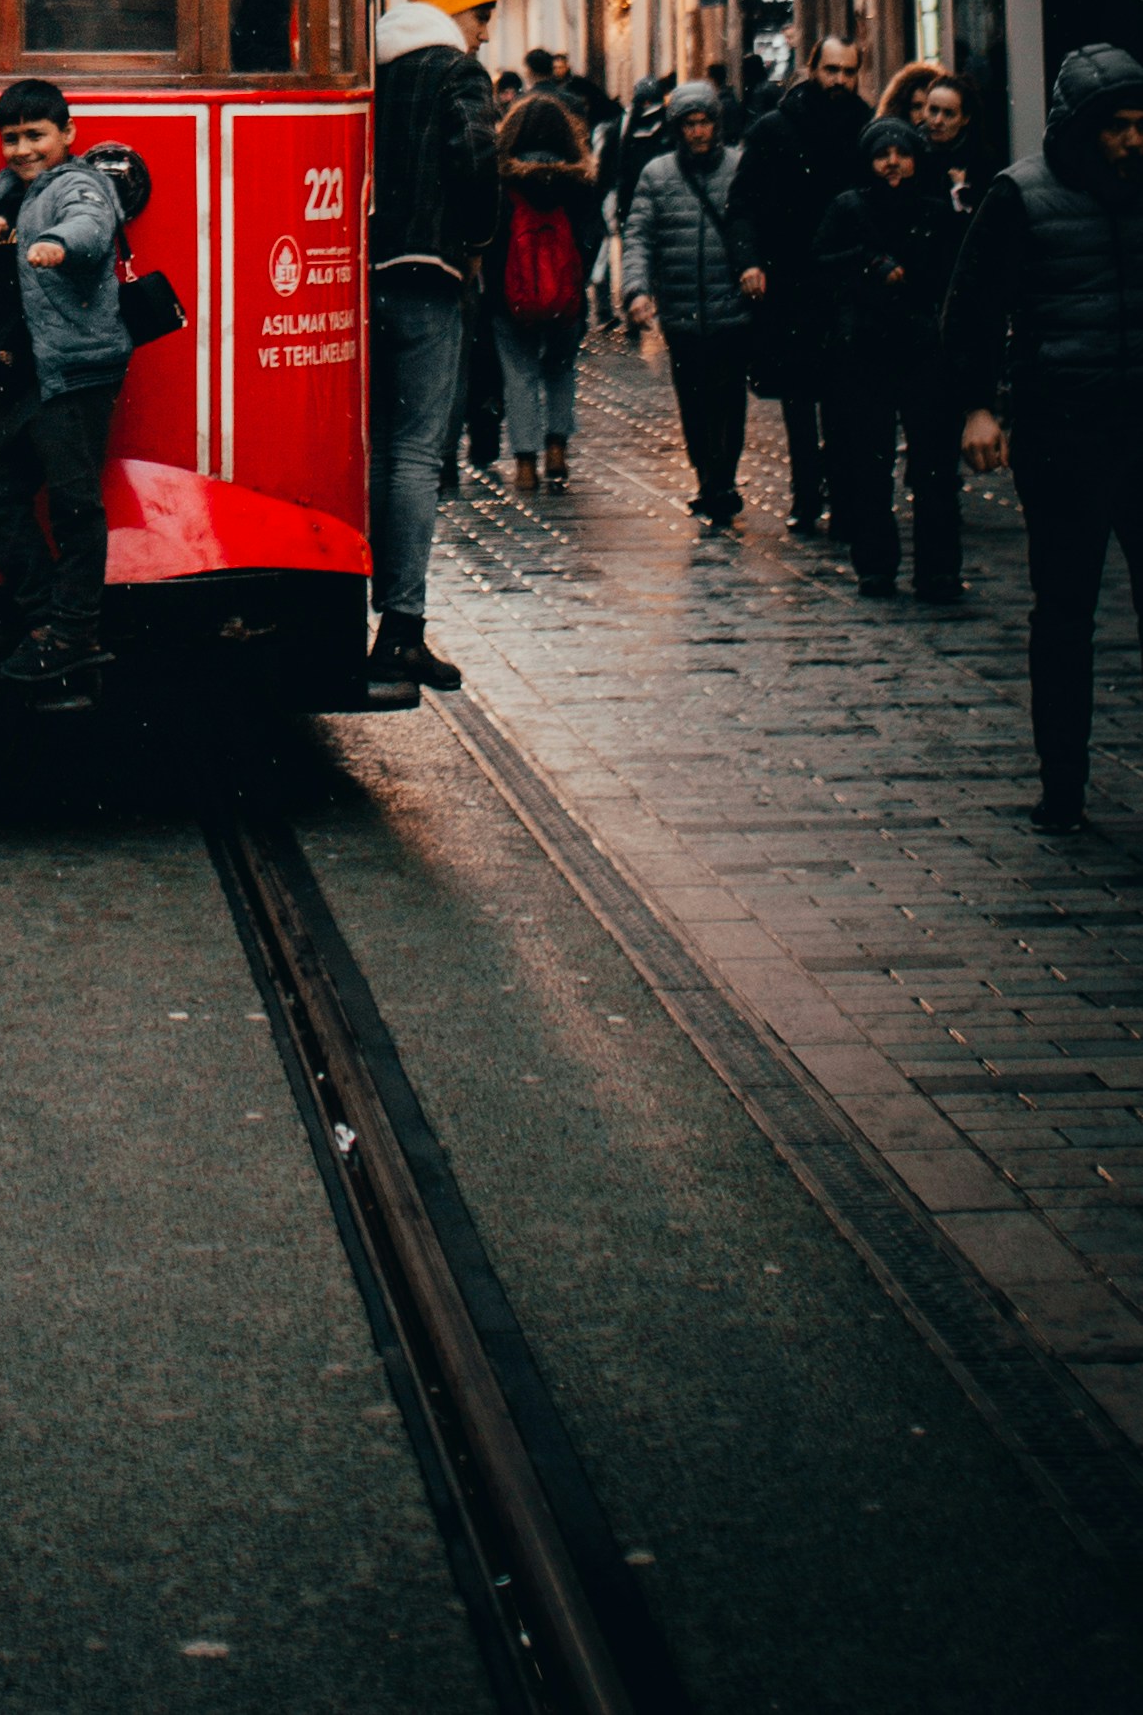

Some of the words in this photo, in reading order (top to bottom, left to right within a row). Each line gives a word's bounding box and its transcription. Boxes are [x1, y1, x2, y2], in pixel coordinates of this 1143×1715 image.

[304, 167, 344, 221] 223
[306, 267, 334, 284] ALO
[261, 313, 326, 336] ASILMAK
[258, 347, 280, 368] VE
